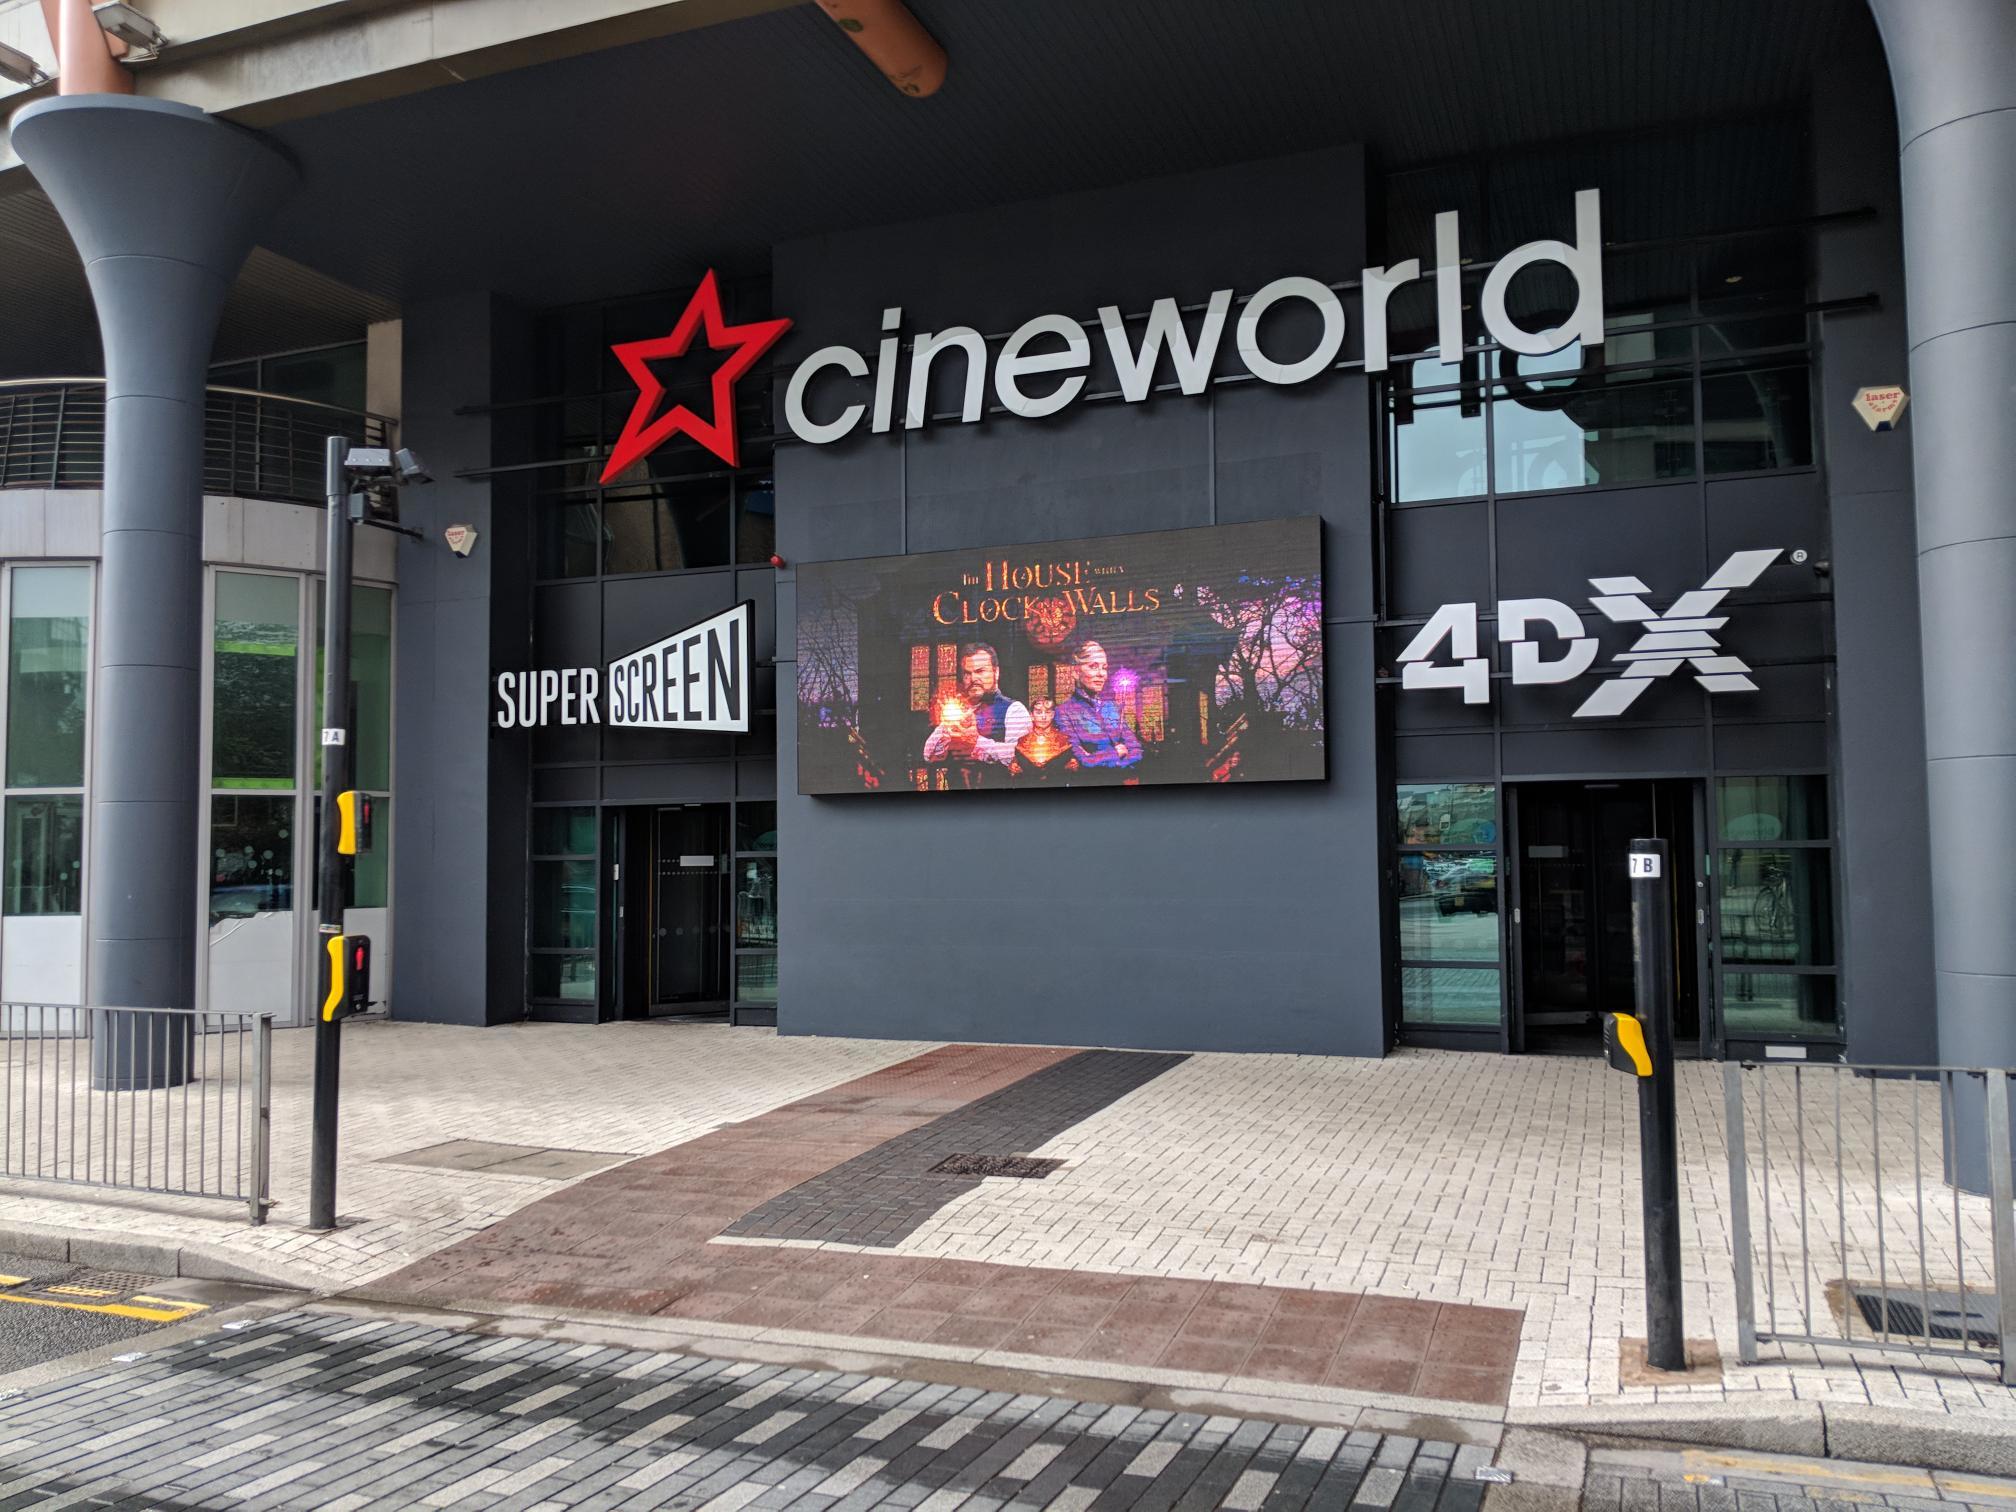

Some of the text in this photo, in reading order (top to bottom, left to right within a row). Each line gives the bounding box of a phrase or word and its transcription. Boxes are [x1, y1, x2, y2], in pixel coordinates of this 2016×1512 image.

[785, 188, 1604, 444] cineworld
[497, 618, 741, 728] SUPER SCREEN
[932, 586, 1160, 625] CLOCK WALLS
[1396, 548, 1784, 718] 4DX
